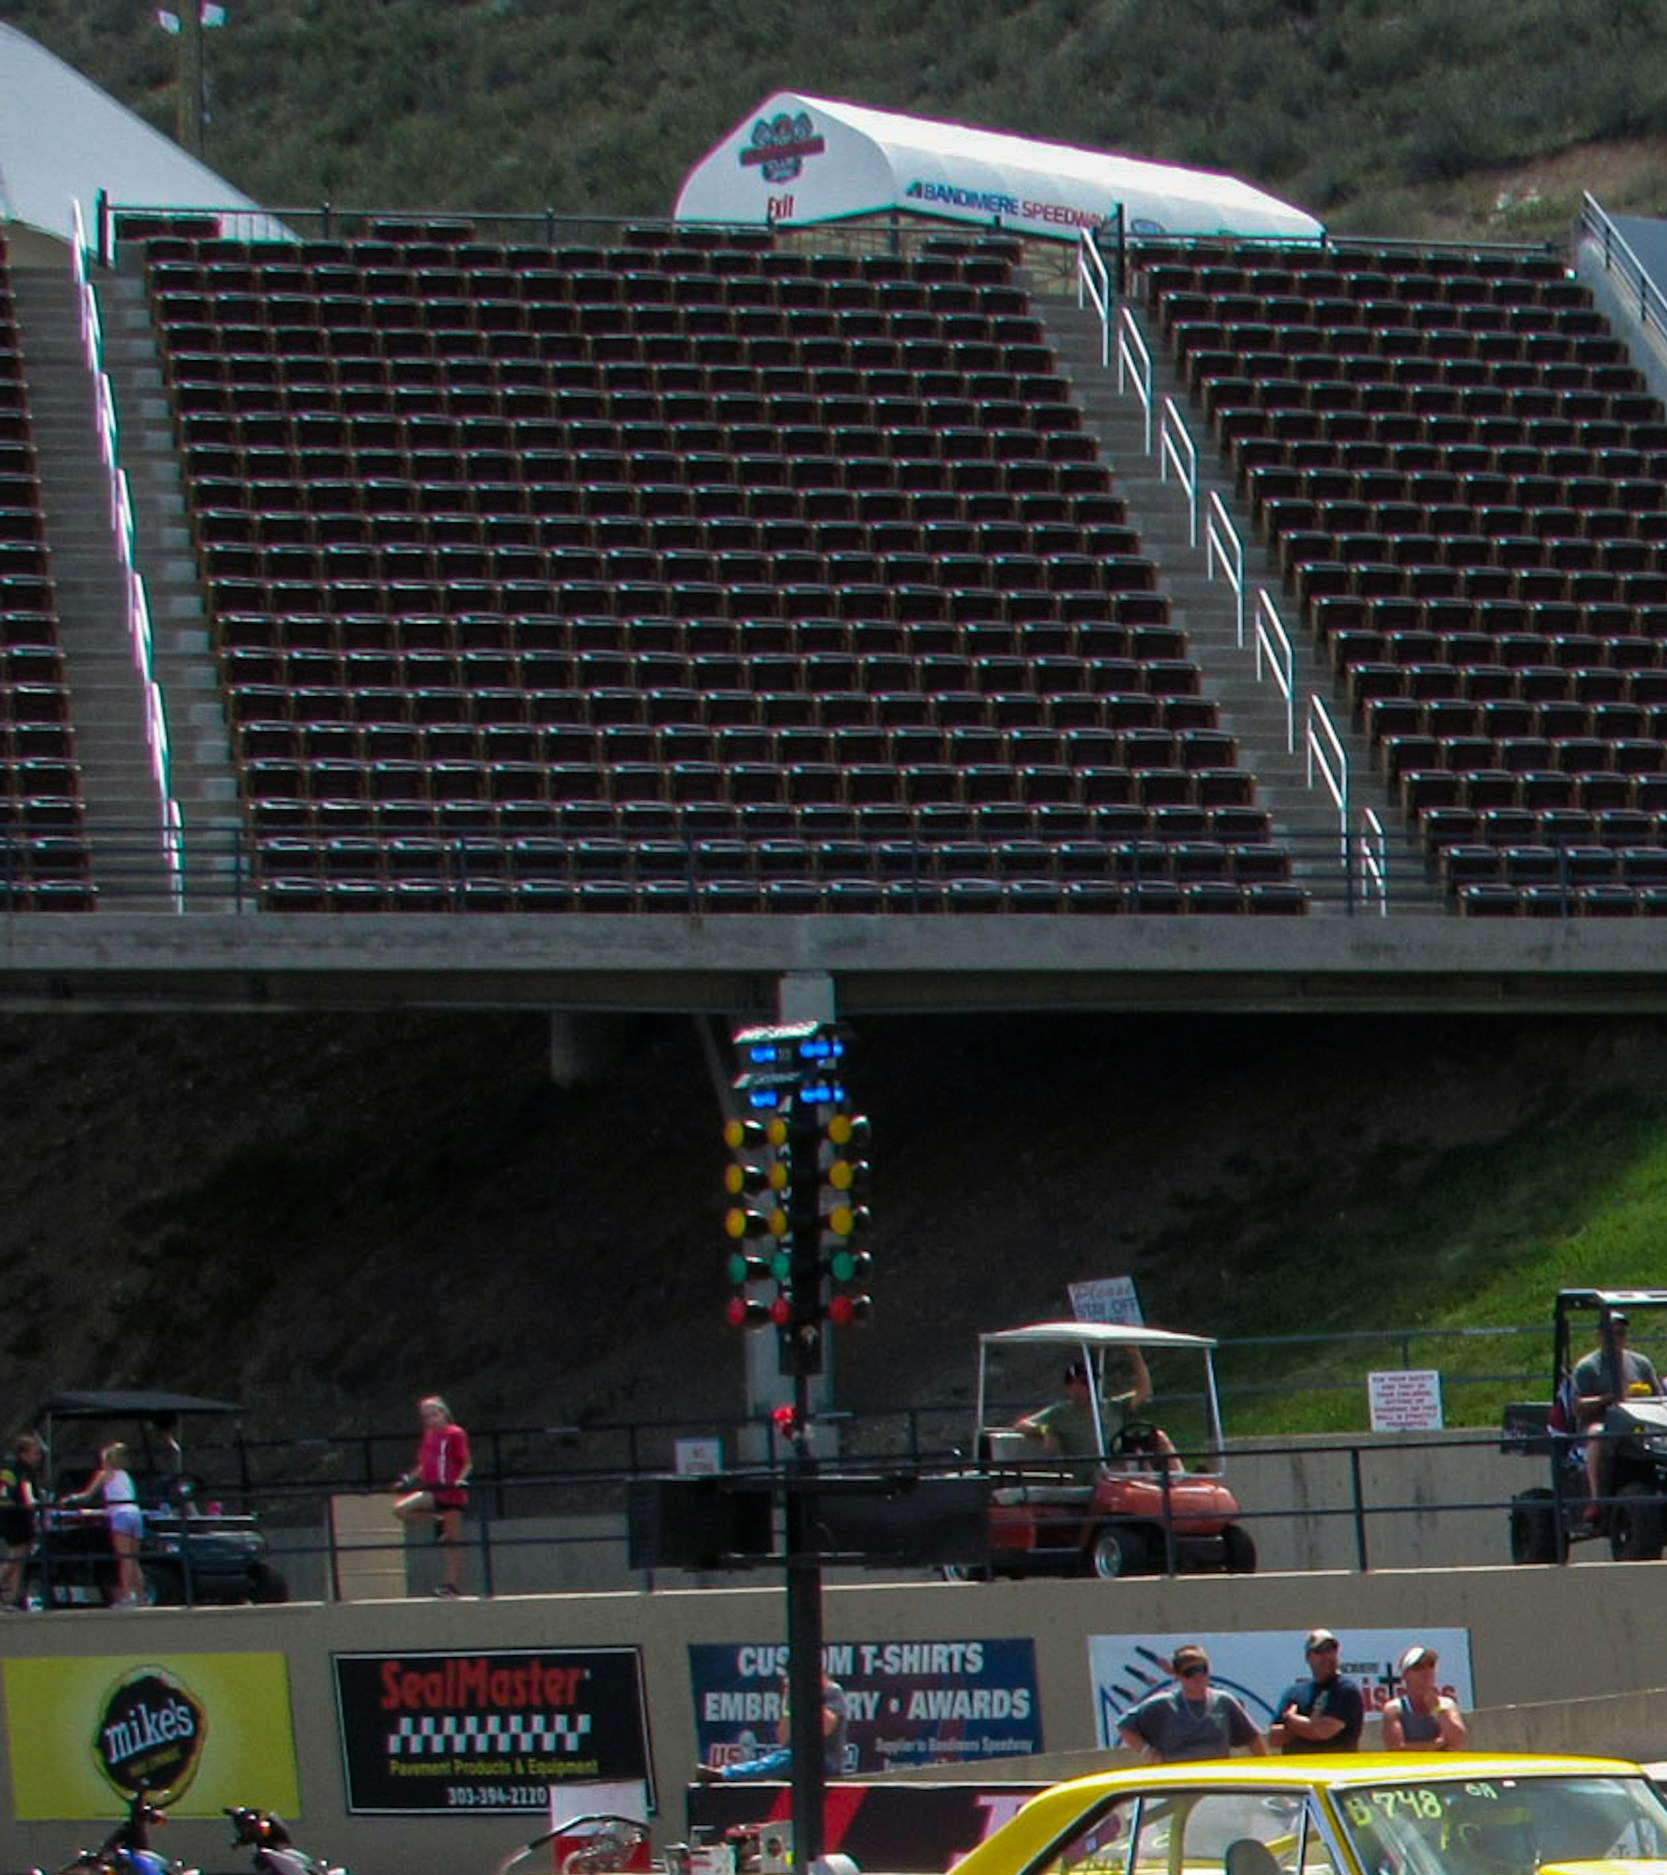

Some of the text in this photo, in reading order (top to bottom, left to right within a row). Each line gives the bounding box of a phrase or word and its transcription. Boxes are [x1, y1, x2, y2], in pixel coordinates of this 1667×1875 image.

[923, 183, 1019, 215] BANDIMERE
[860, 1643, 984, 1675] T-SHIRTS
[380, 1658, 582, 1710] SealMaster
[907, 1688, 1031, 1720] AWARDS
[104, 1698, 195, 1765] mike's
